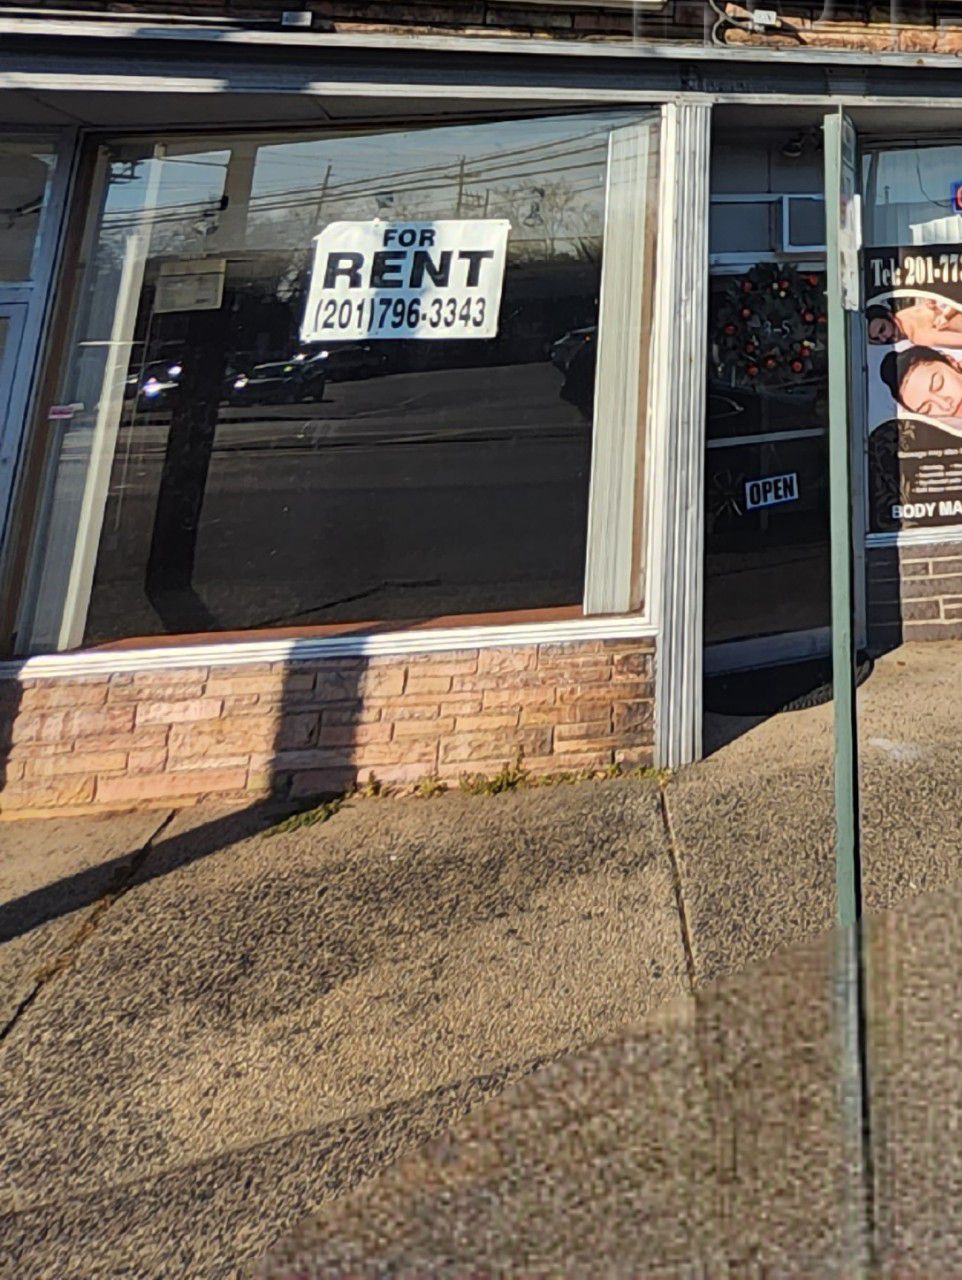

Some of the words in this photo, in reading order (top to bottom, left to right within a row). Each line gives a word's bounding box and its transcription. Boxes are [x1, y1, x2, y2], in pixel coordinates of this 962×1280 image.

[383, 228, 436, 247] FOR
[322, 250, 494, 289] RENT
[749, 475, 795, 506] OPEN
[891, 501, 936, 519] BODY
